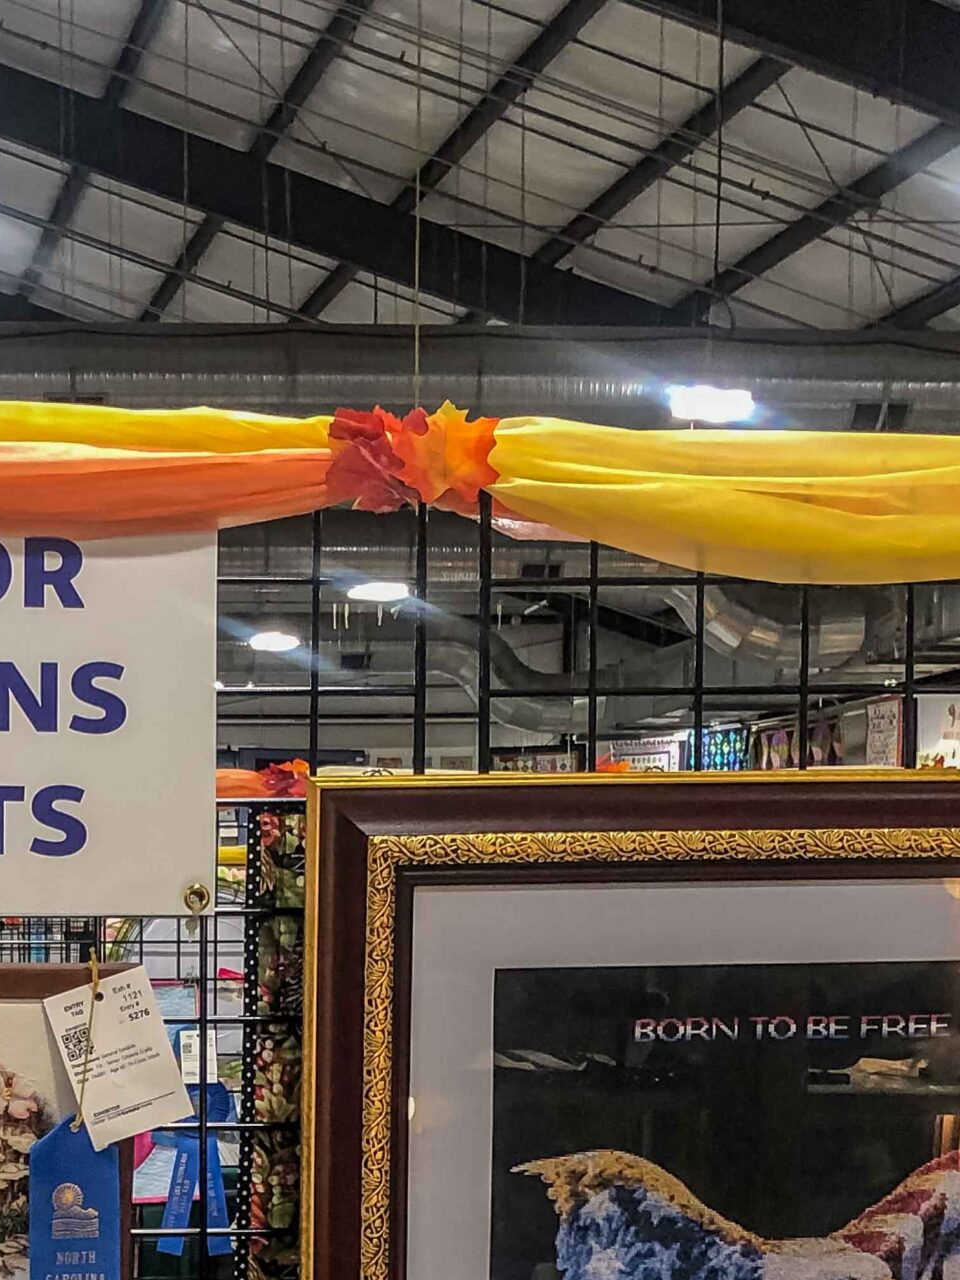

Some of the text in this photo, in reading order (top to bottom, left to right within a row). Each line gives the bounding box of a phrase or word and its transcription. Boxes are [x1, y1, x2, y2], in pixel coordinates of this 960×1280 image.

[123, 990, 143, 1002] 1121
[128, 1008, 150, 1021] 5276
[634, 1013, 953, 1042] BORN TO BE FREE
[56, 1251, 96, 1265] NORTH
